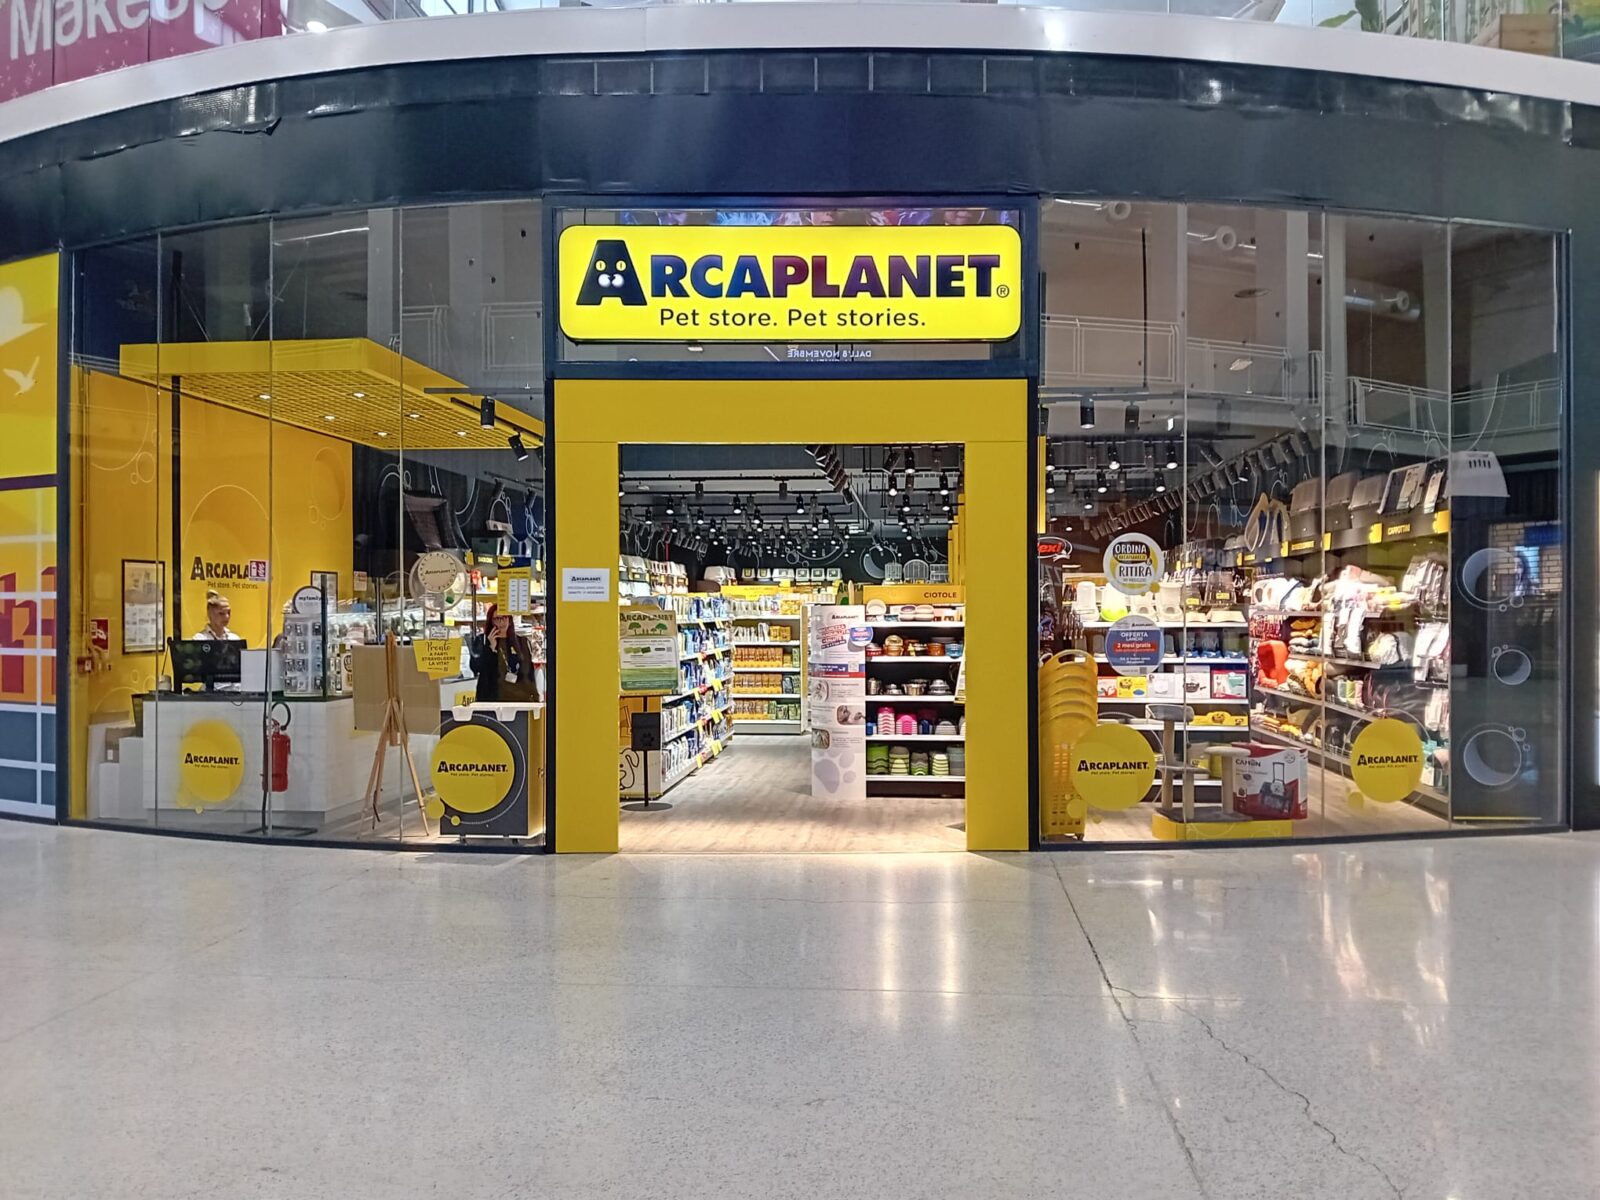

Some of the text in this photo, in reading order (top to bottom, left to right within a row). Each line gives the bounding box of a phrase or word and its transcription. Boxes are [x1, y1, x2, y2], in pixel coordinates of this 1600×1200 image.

[659, 308, 926, 327] Pet store. Pet stories.
[1115, 544, 1147, 554] ORDINA
[1119, 565, 1152, 577] RITIRA
[425, 640, 452, 652] Pronto
